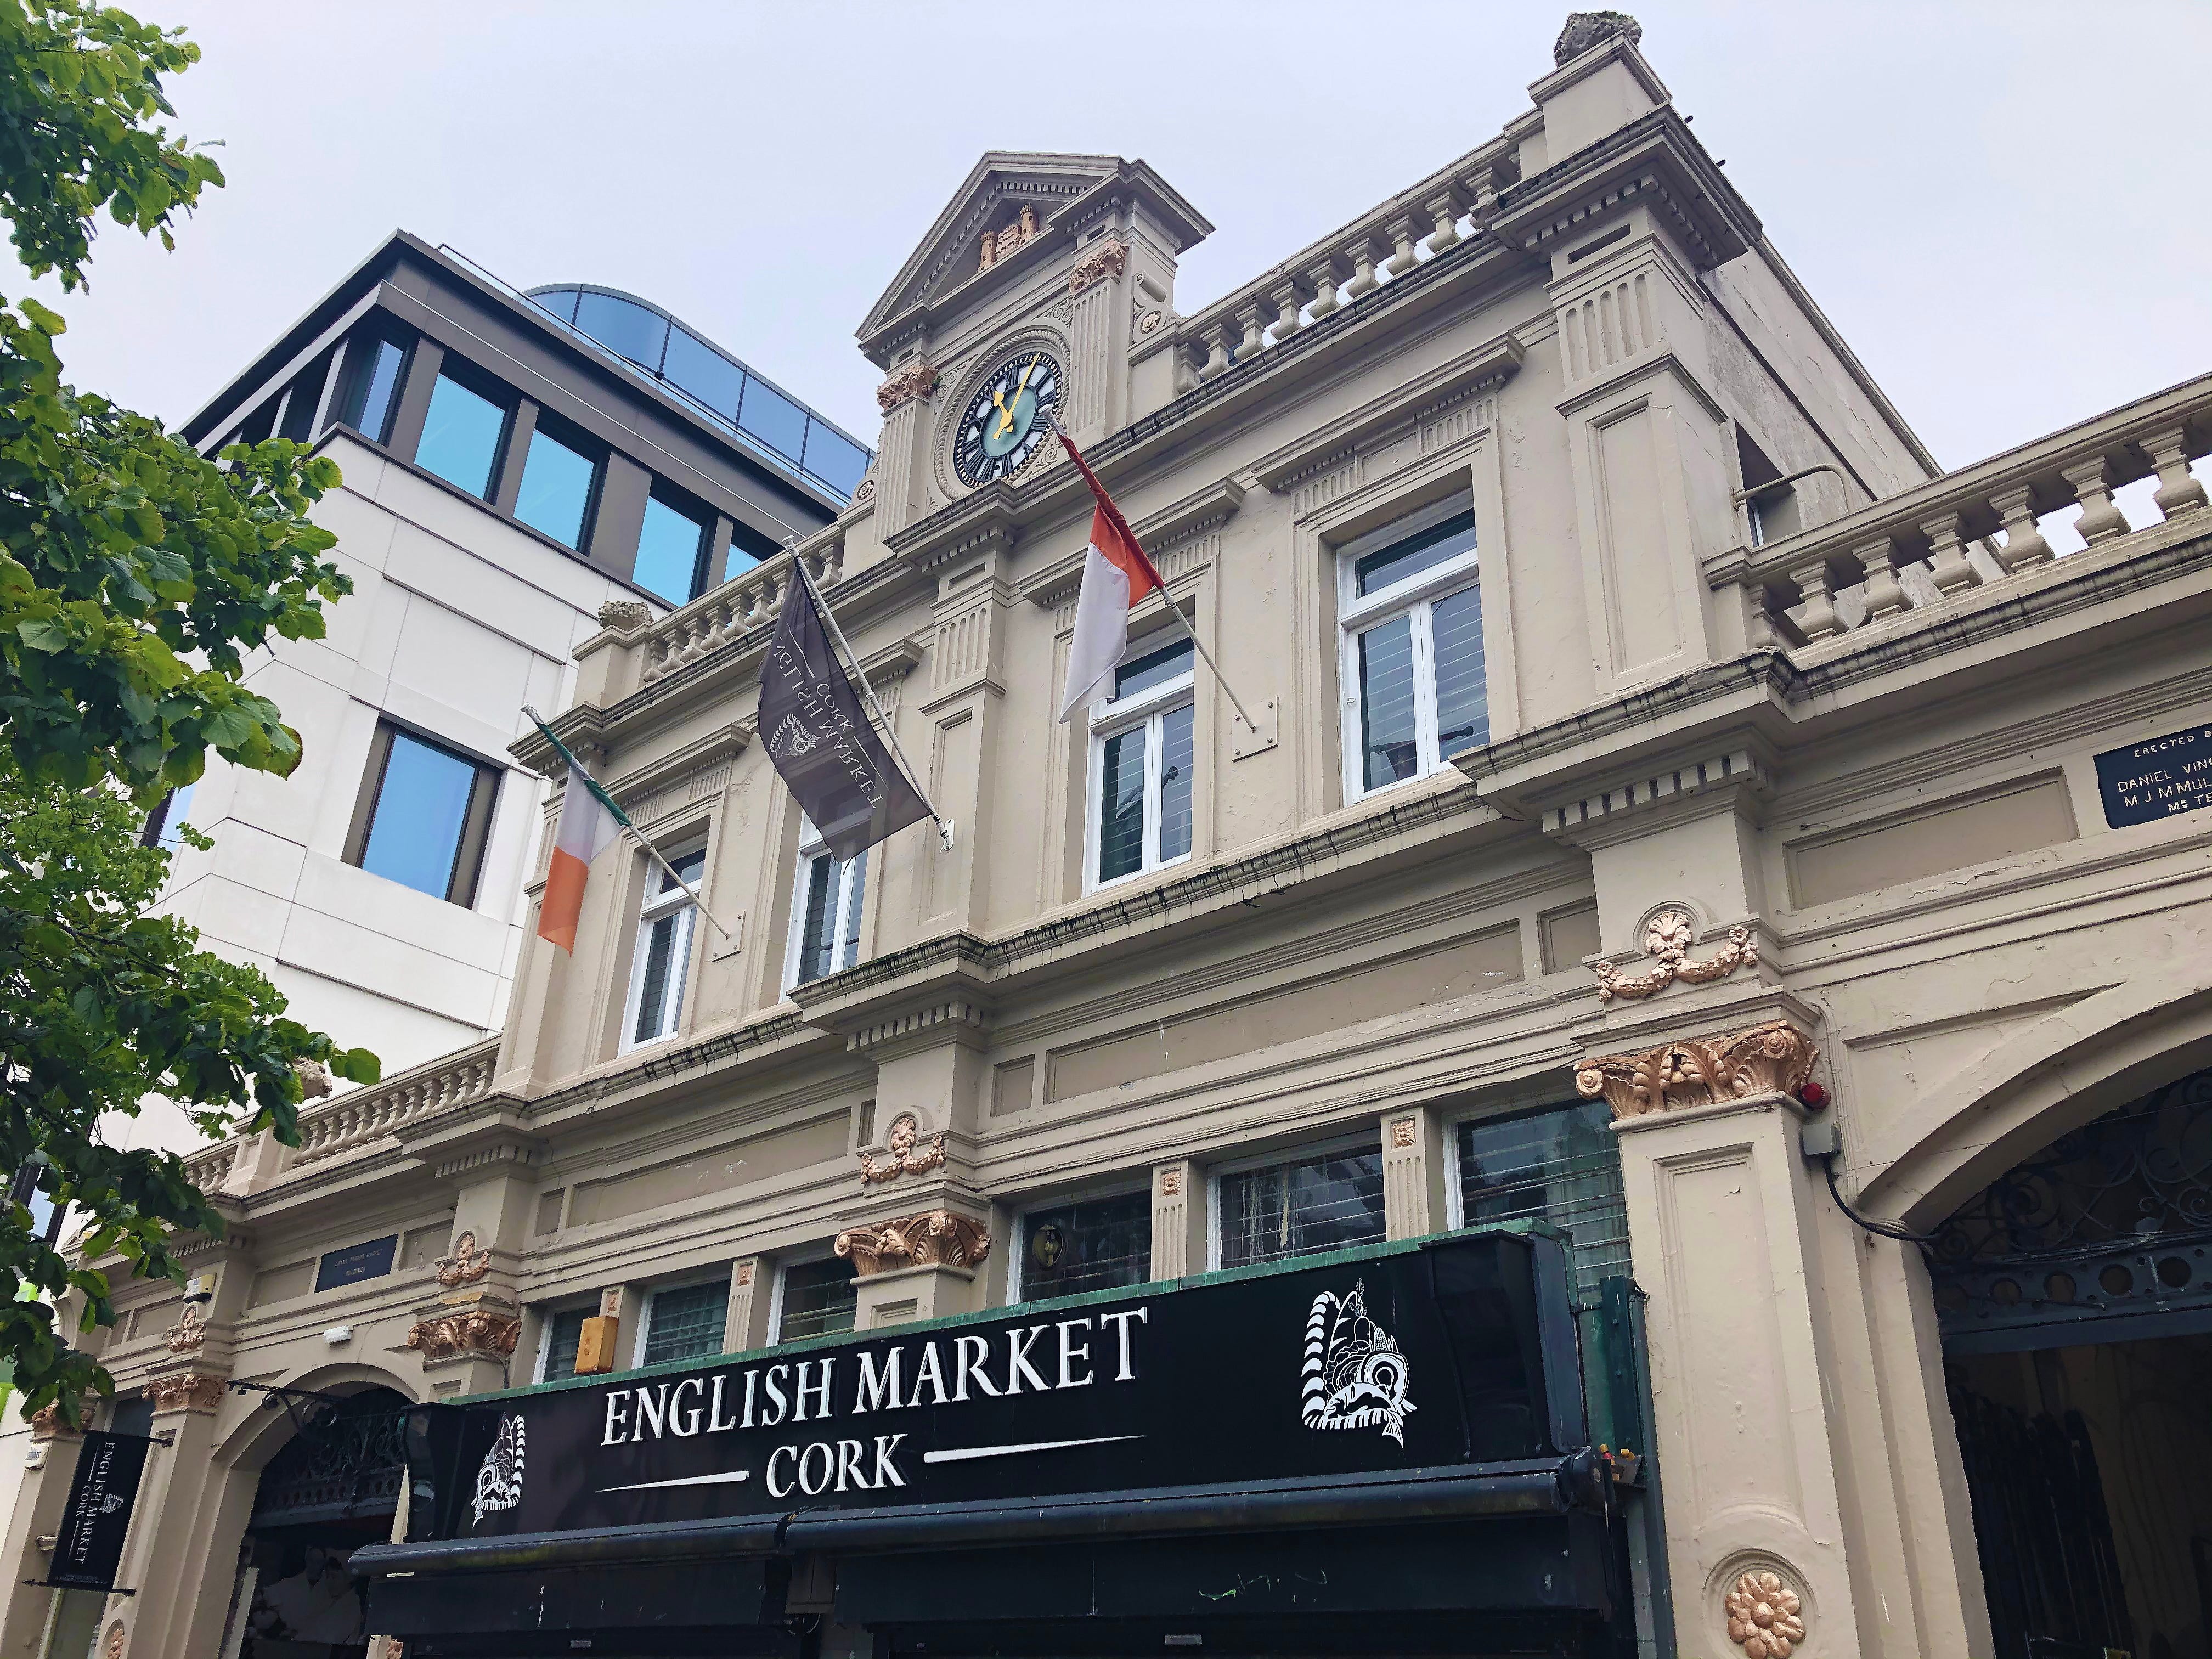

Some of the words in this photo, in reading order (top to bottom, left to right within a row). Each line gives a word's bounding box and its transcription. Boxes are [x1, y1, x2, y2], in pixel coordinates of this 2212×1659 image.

[2134, 735, 2195, 758] ERECTED
[2117, 770, 2174, 793] DANIEL
[2124, 794, 2138, 808] M
[2143, 791, 2152, 803] J
[601, 1357, 837, 1446] ENGLISH
[851, 1306, 1148, 1415] MARKET
[91, 1442, 115, 1502] ENGLISH
[767, 1433, 908, 1498] CORK
[76, 1485, 91, 1517] CORK
[75, 1505, 98, 1565] MARKET
